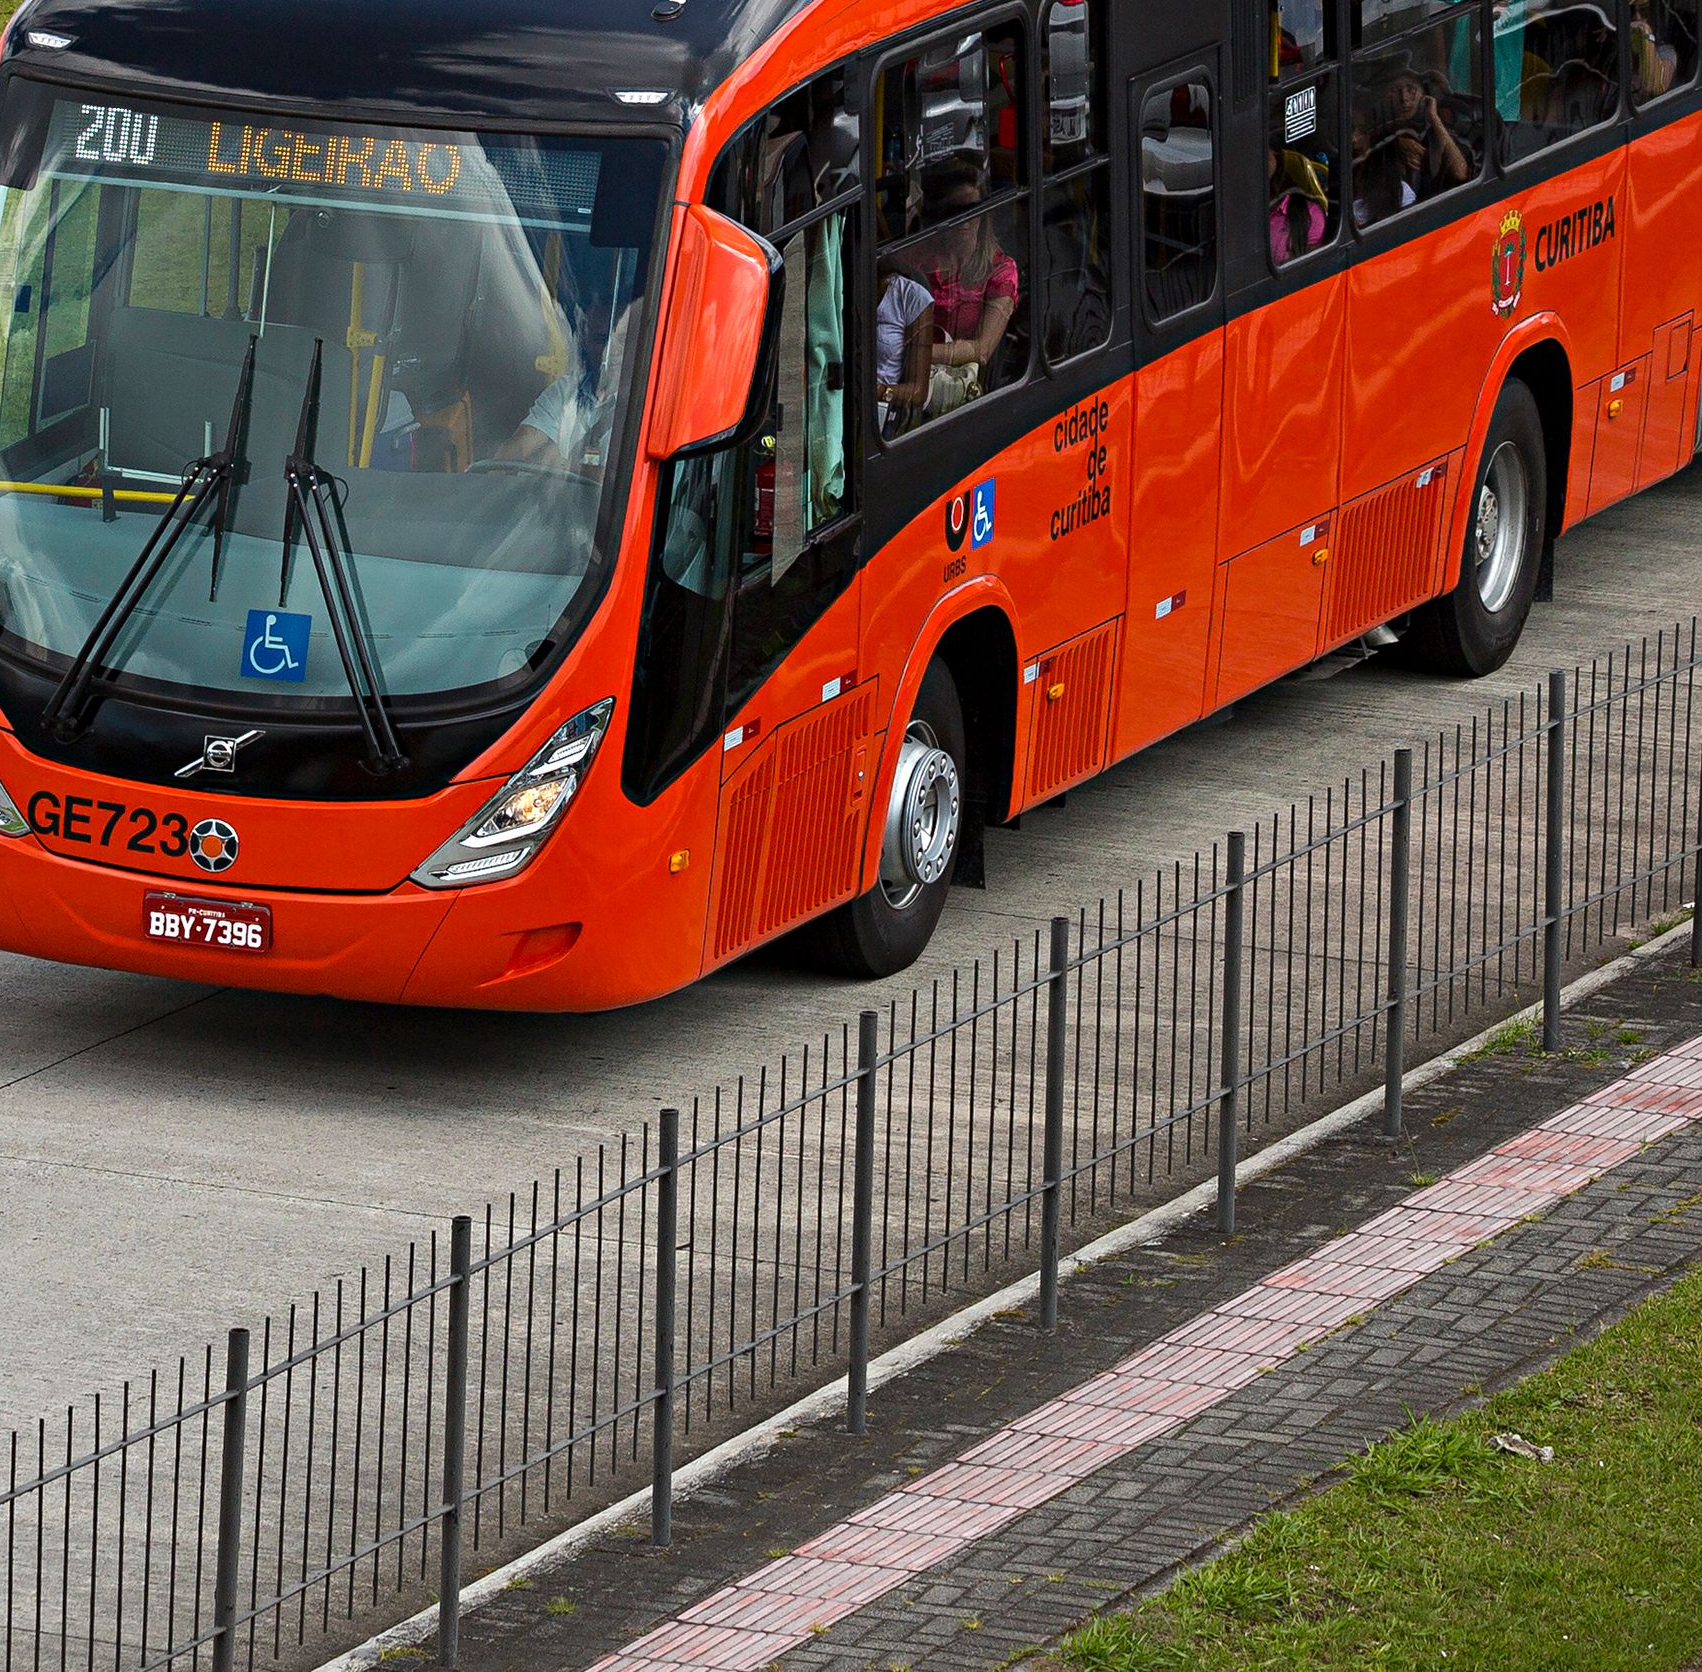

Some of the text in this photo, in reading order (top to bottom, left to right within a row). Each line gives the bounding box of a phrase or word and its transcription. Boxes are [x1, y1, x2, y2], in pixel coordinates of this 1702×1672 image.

[1535, 195, 1615, 272] CURITIBA
[1054, 396, 1109, 452] cidade
[1050, 483, 1111, 541] curitiba
[943, 555, 967, 583] URBS
[27, 791, 188, 857] GE723
